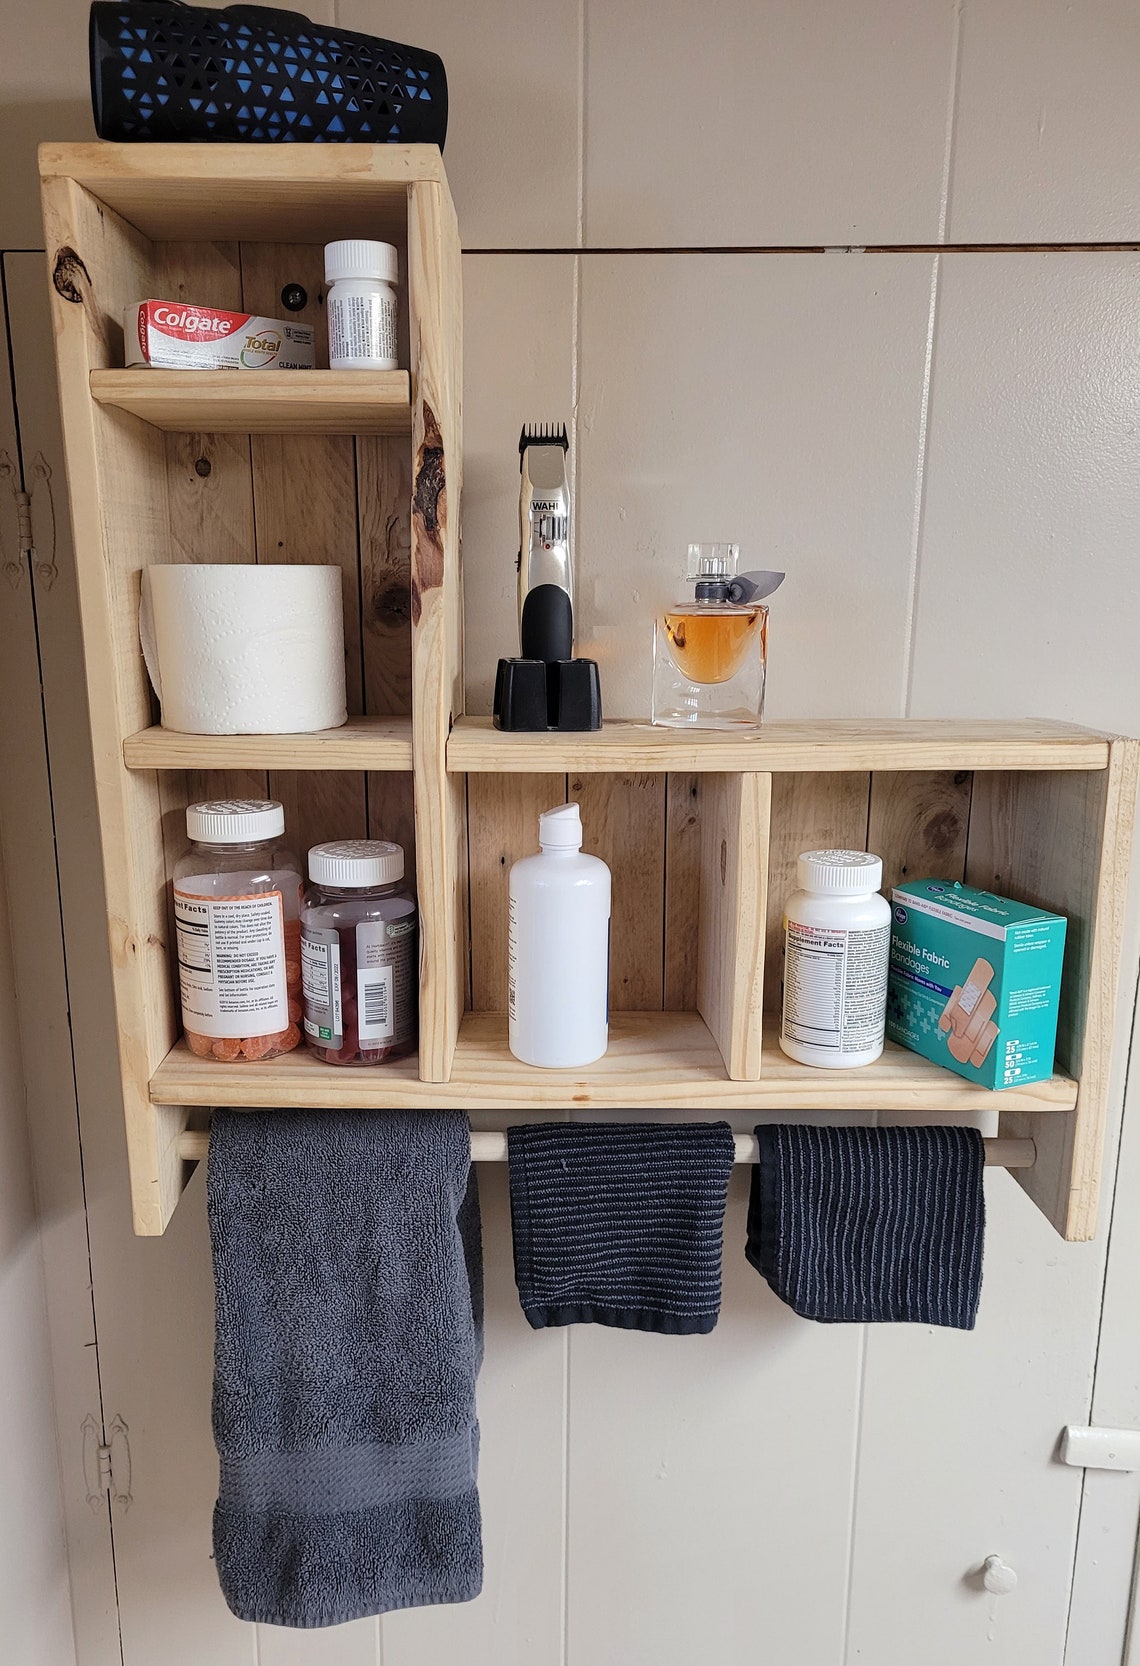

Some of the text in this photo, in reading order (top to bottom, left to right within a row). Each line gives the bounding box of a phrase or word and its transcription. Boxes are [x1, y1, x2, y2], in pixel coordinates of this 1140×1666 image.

[153, 307, 232, 334] Colgate
[245, 334, 282, 352] Total
[278, 362, 298, 370] CLEAN
[184, 904, 207, 914] Facts
[788, 933, 822, 947] Supplement
[308, 944, 326, 953] Facts
[892, 935, 950, 969] Flexible Fabric
[891, 948, 930, 974] Bandages
[1006, 1046, 1015, 1054] 25
[1004, 1060, 1015, 1069] 50
[1003, 1076, 1013, 1085] 25
